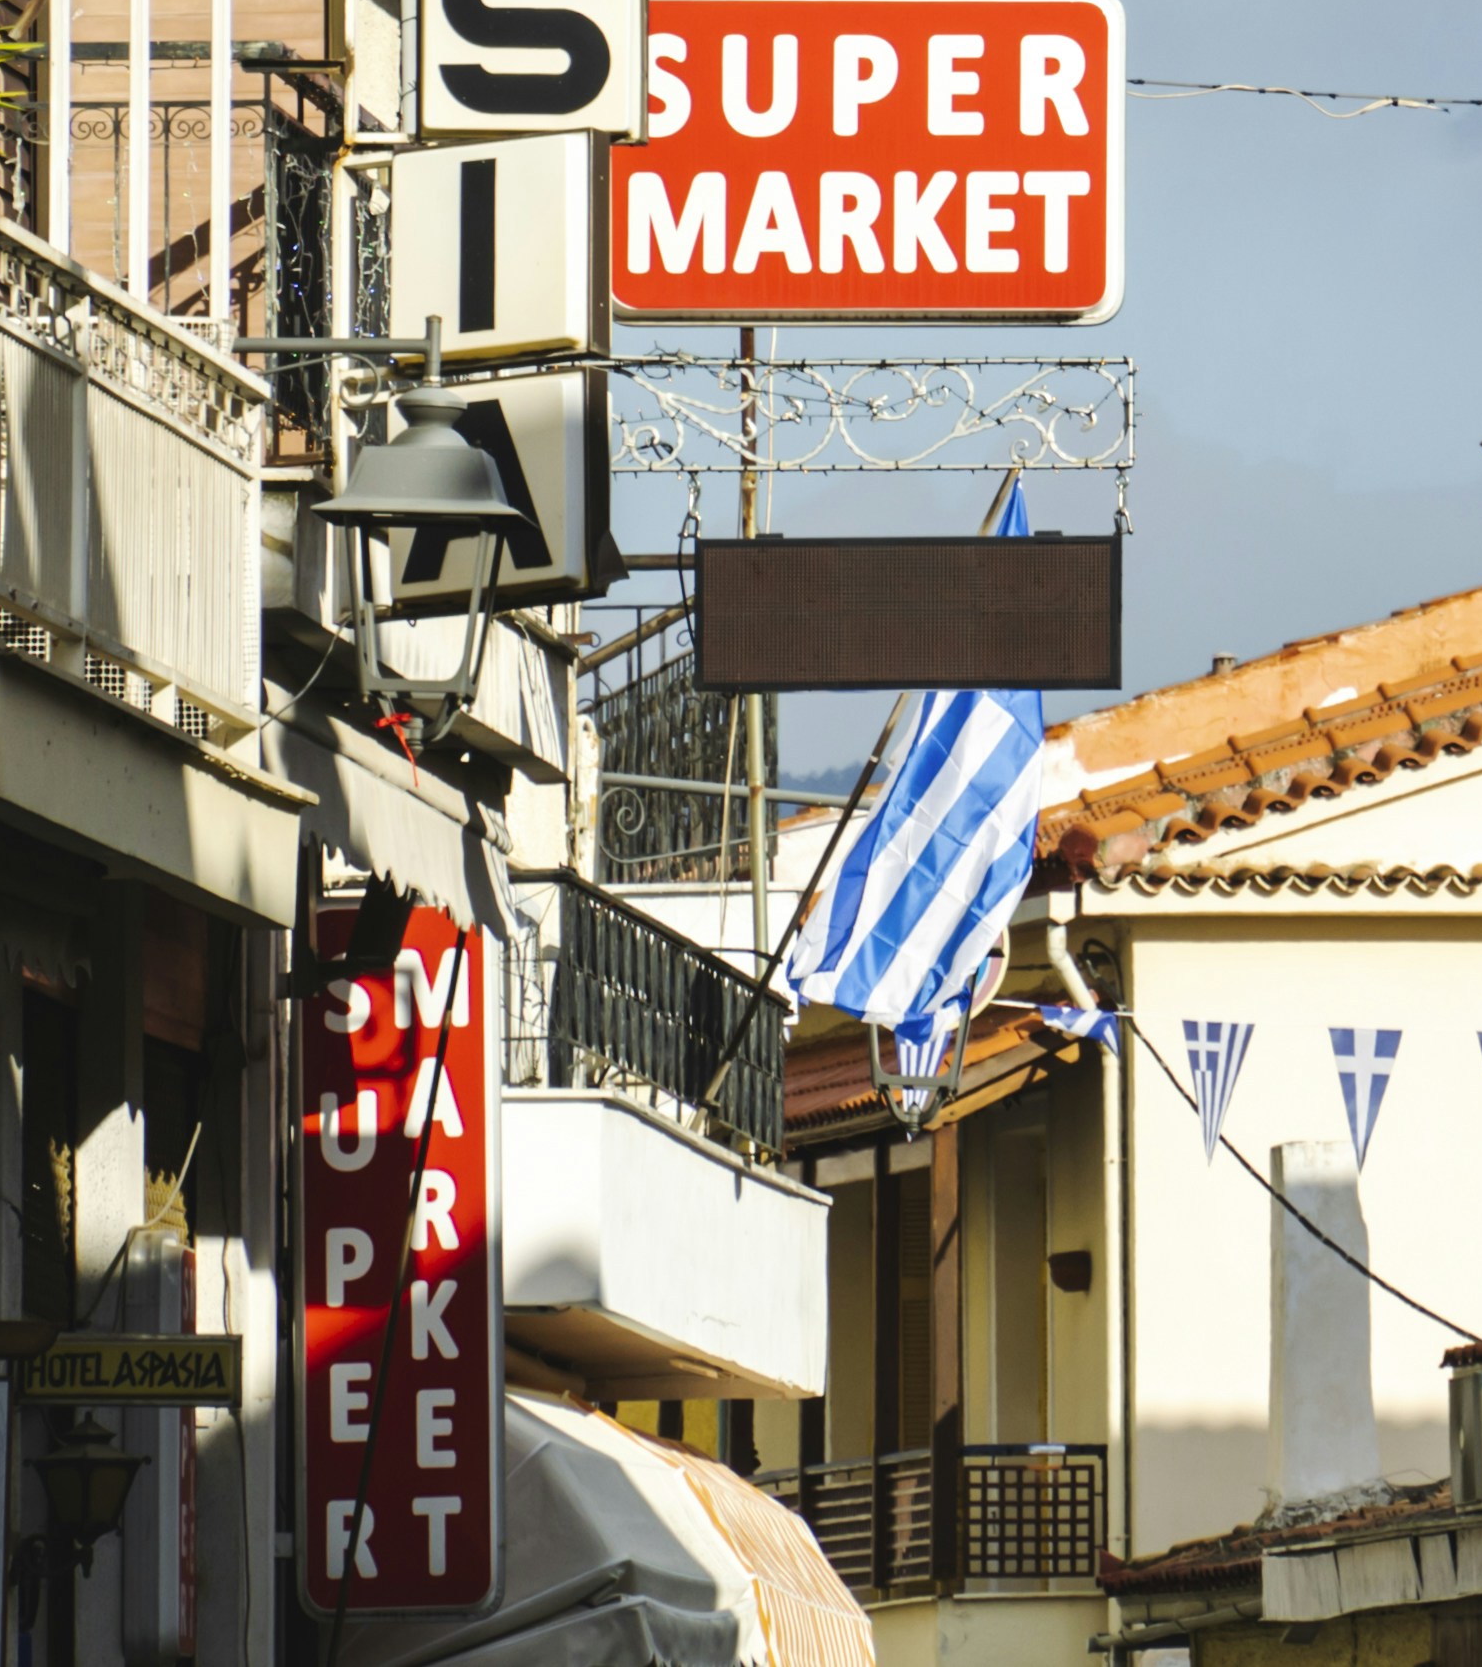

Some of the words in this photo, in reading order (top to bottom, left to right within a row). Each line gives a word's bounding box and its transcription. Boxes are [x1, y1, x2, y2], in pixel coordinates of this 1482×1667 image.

[648, 32, 1090, 138] SUPER
[627, 170, 1091, 275] MARKET
[320, 961, 378, 1580] SUPER
[392, 947, 469, 1576] MARKET
[26, 1351, 110, 1389] HOTEL
[112, 1350, 226, 1389] ASPASIA
